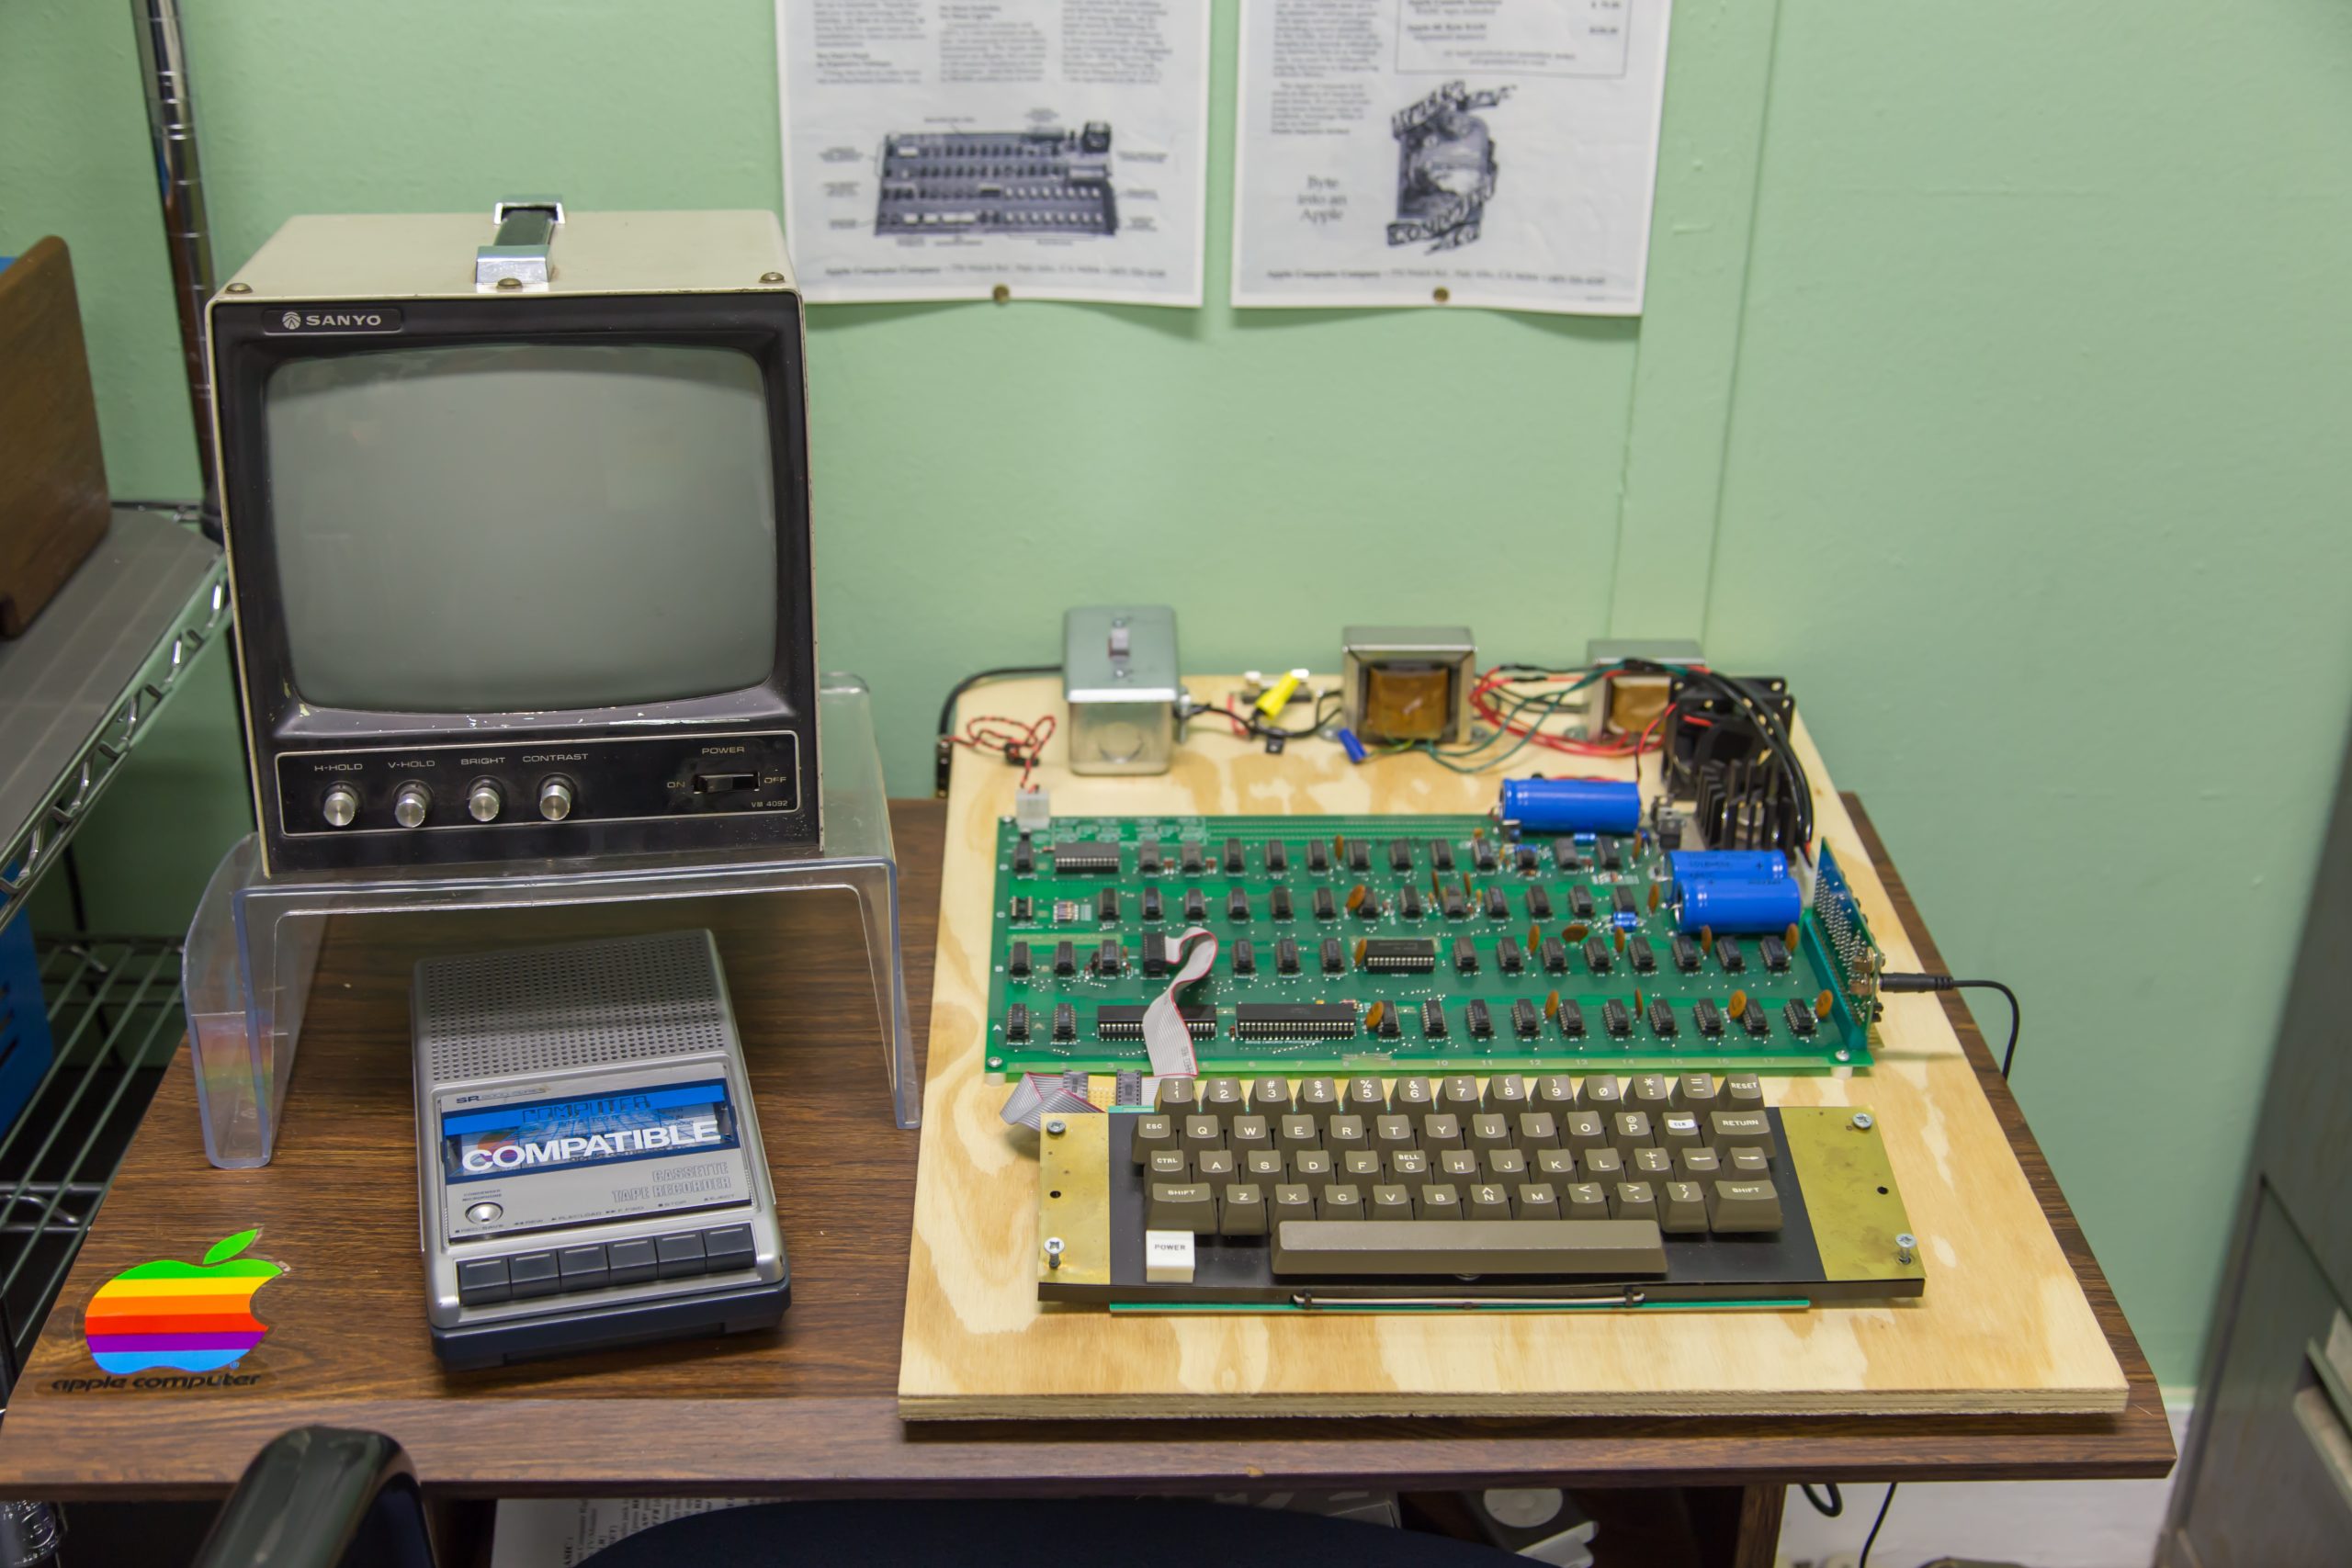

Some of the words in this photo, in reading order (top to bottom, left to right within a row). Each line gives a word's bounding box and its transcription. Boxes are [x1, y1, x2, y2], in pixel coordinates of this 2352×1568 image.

[1307, 175, 1339, 191] Byte
[1296, 192, 1326, 205] into
[1329, 194, 1347, 205] an
[1300, 207, 1344, 224] Apple
[306, 315, 381, 326] SANYO
[701, 746, 745, 754] POWER
[460, 756, 506, 765] BRIGHT
[522, 753, 589, 763] CONTRAST
[314, 763, 363, 772] H-HOLD
[388, 760, 435, 769] V-HOLD
[992, 1023, 1002, 1032] A
[1730, 1081, 1758, 1089] RESET
[1174, 1089, 1180, 1099] 1
[1219, 1089, 1229, 1100] 2
[1267, 1089, 1277, 1099] 3
[1314, 1089, 1325, 1099] 4
[1363, 1089, 1373, 1099] 5
[1409, 1089, 1419, 1099] 6
[1456, 1088, 1466, 1098] 7
[1504, 1087, 1515, 1096] 8
[1551, 1087, 1562, 1097] 9
[456, 1095, 480, 1104] SR
[522, 1095, 650, 1123] COMPUTER
[1625, 1115, 1637, 1124] @
[1197, 1126, 1208, 1135] Q
[1243, 1126, 1257, 1136] W
[1294, 1126, 1305, 1135] E
[1341, 1126, 1352, 1136] R
[1389, 1126, 1399, 1136] T
[1437, 1125, 1447, 1134] Y
[1485, 1125, 1496, 1135] U
[1580, 1122, 1591, 1133] O
[1628, 1123, 1638, 1133] P
[462, 1120, 721, 1171] COMPATIBLE
[1211, 1161, 1222, 1170] A
[1260, 1161, 1271, 1170] S
[1308, 1161, 1318, 1170] D
[1357, 1161, 1367, 1170] F
[1405, 1161, 1416, 1170] G
[1453, 1161, 1465, 1170] H
[1503, 1160, 1512, 1169] J
[1550, 1160, 1562, 1169] K
[1599, 1159, 1611, 1168] L
[651, 1161, 729, 1182] CASSETTE
[612, 1186, 650, 1203] TAPE
[652, 1176, 731, 1197] RECORDER
[1238, 1192, 1249, 1201] Z
[1288, 1193, 1298, 1201] X
[1337, 1193, 1348, 1201] C
[1385, 1193, 1396, 1201] V
[1434, 1193, 1446, 1202] B
[1483, 1193, 1495, 1201] N
[1531, 1192, 1544, 1201] M
[51, 1376, 127, 1393] apple
[132, 1373, 261, 1390] computer
